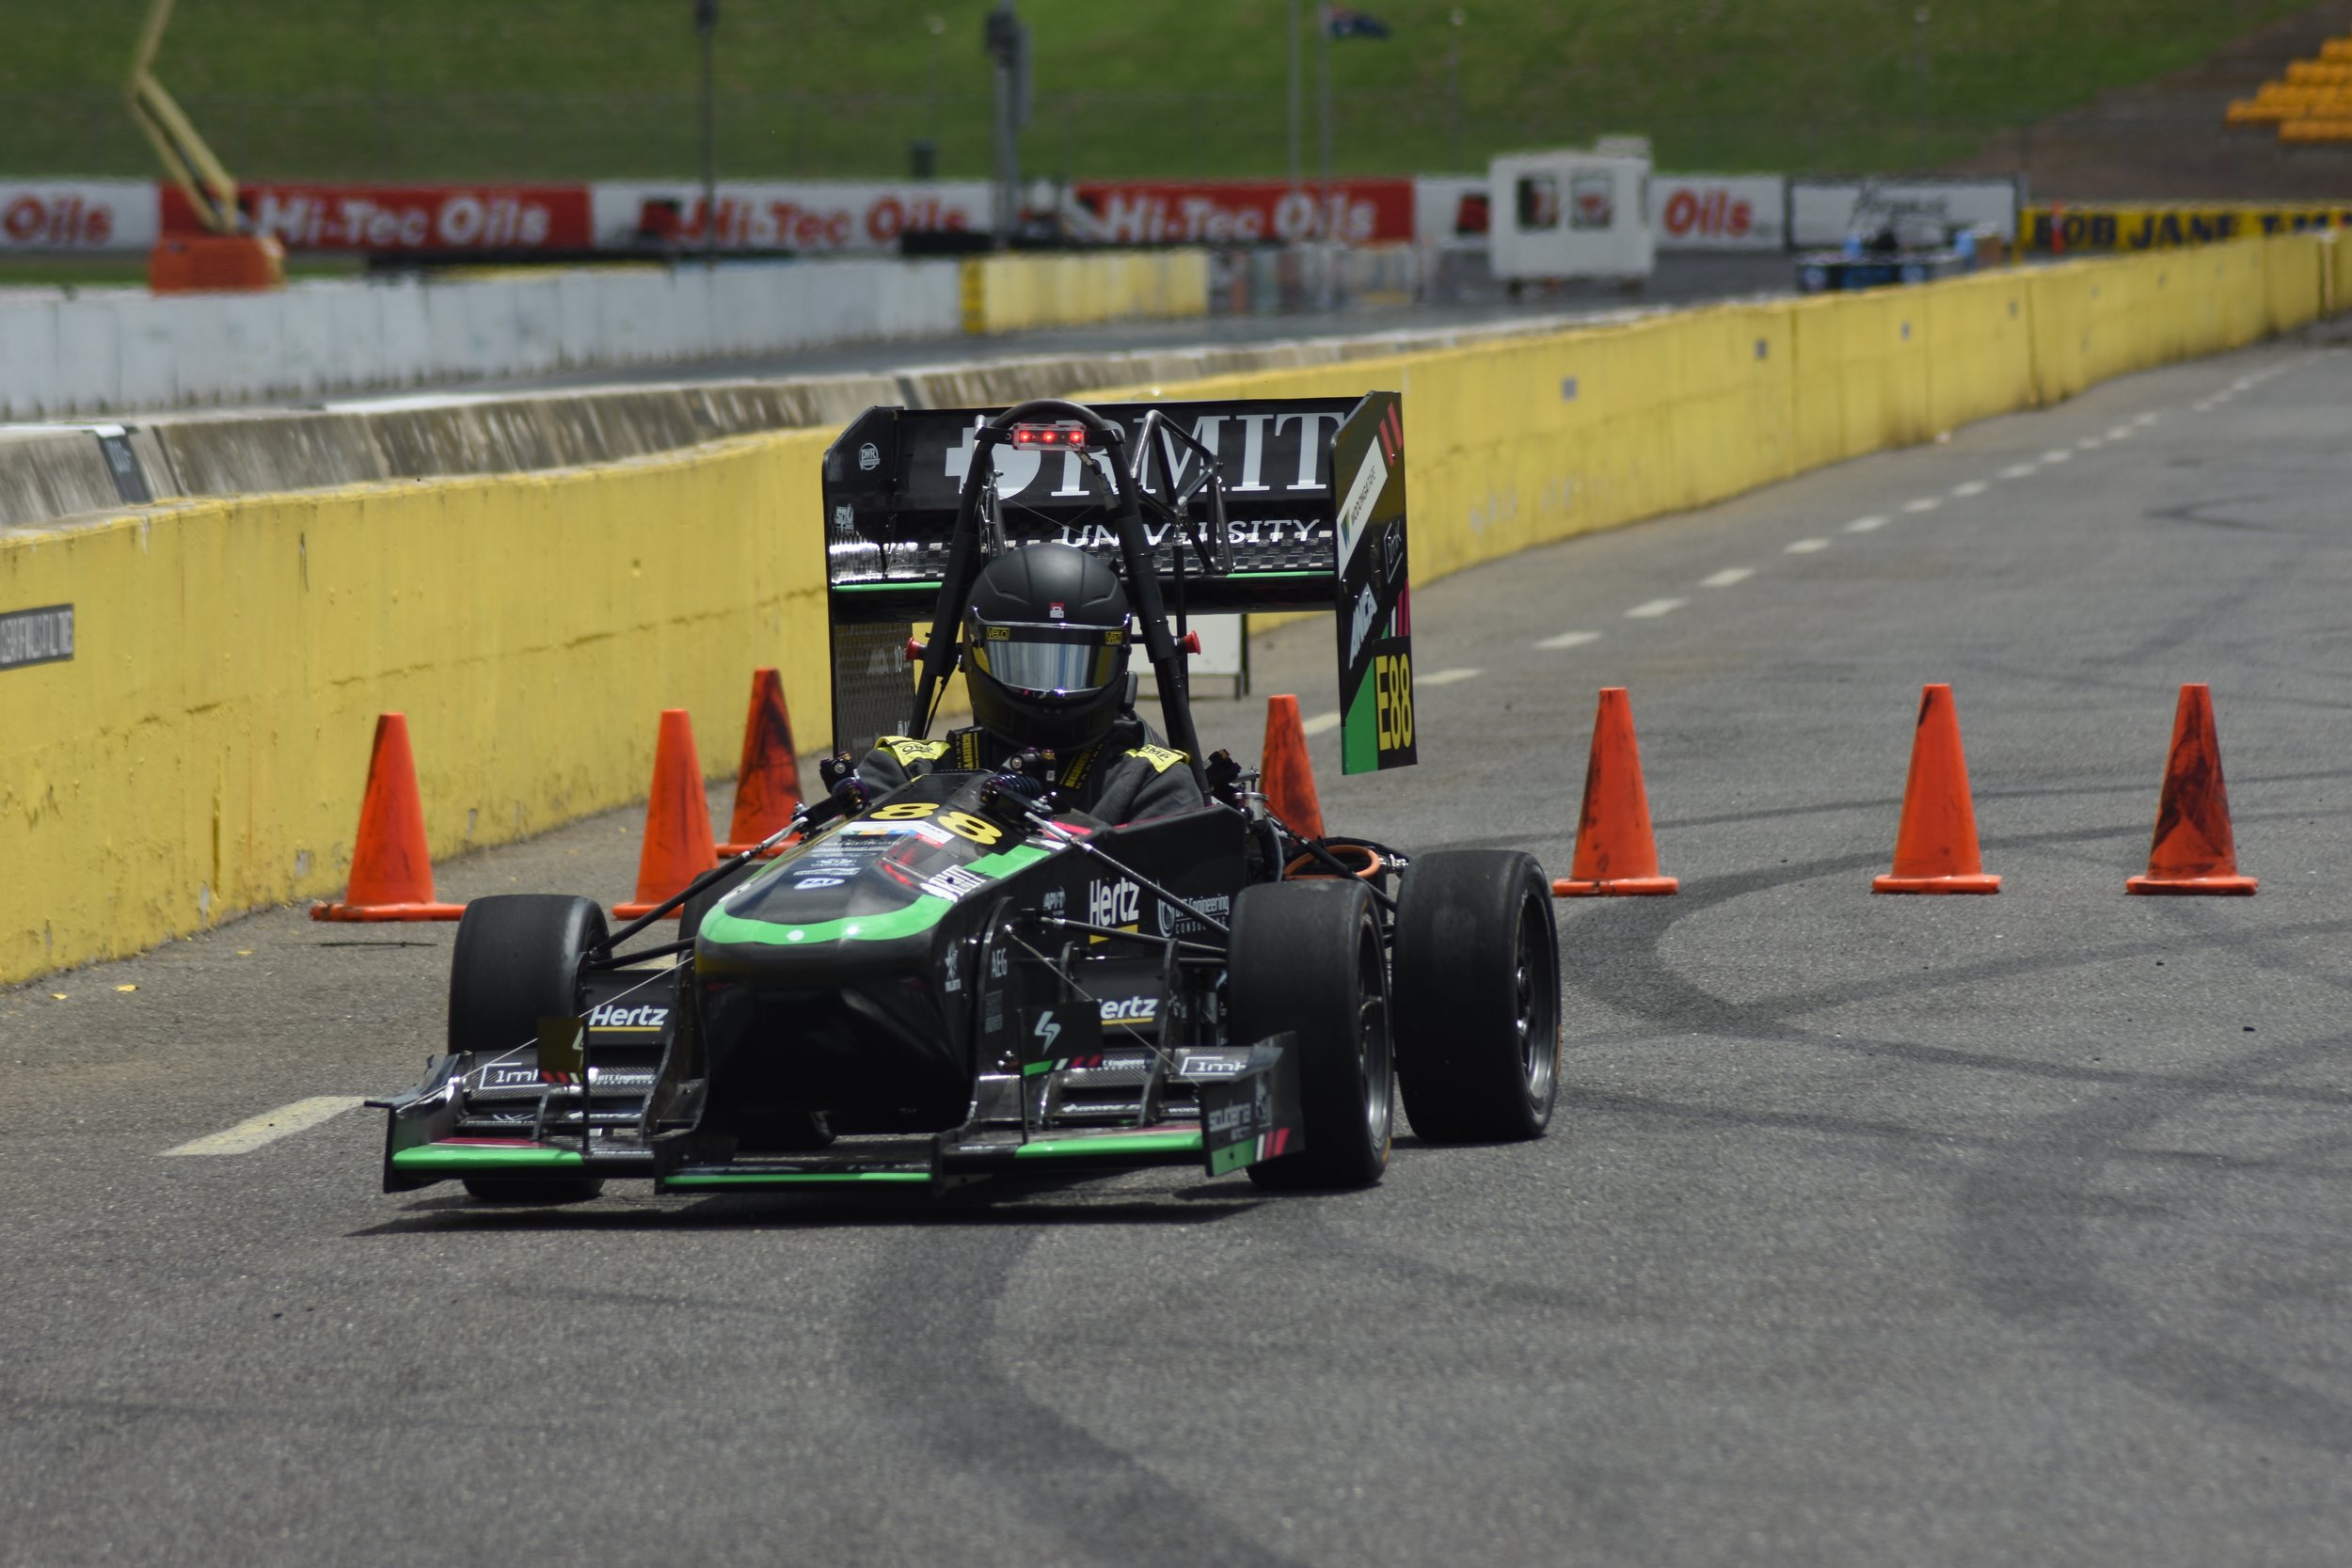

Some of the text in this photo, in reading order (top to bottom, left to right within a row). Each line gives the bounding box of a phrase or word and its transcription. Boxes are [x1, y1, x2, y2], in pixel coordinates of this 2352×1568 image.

[3, 196, 114, 244] Oils
[256, 196, 551, 246] Hi-Tec Oils
[1104, 193, 1262, 243] Hi-Tec
[1661, 189, 1754, 237] Oils
[1063, 518, 1320, 547] UNVSITY
[1375, 653, 1412, 751] E88
[1089, 876, 1140, 927] Hertz
[589, 1004, 669, 1027] Hertz
[1097, 996, 1159, 1020] ertz
